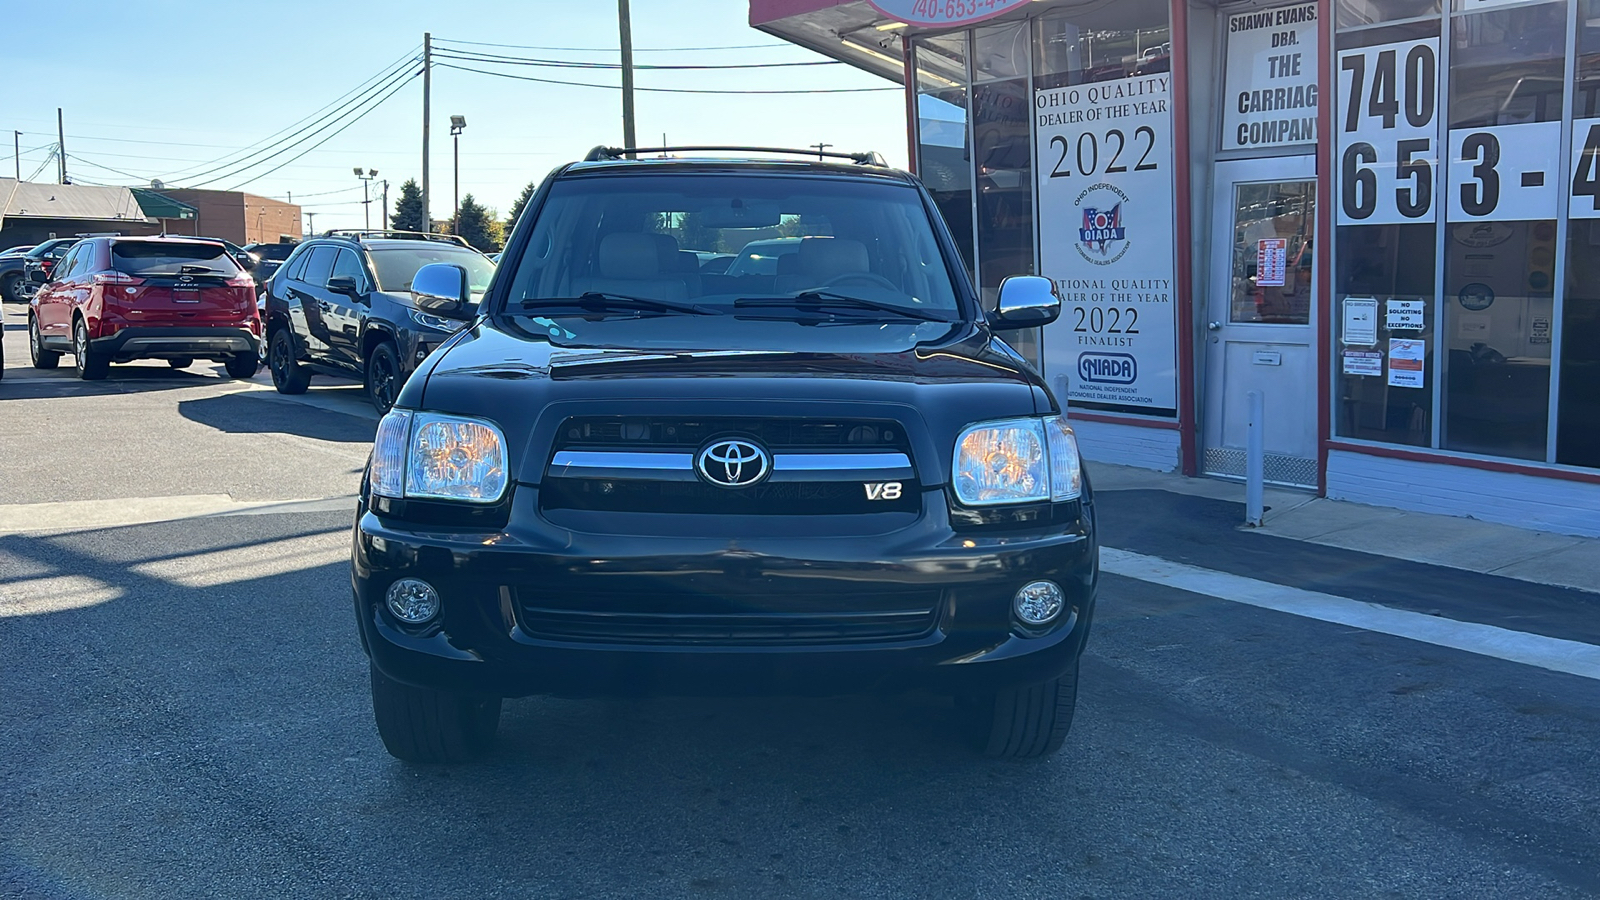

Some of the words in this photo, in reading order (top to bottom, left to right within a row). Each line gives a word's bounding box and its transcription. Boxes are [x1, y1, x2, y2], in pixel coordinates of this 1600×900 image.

[1230, 12, 1273, 33] SHAWN
[1276, 5, 1318, 26] EVANS.
[1271, 30, 1300, 48] DBA.
[1267, 53, 1302, 79] THE
[1036, 90, 1080, 109] OHIO
[1088, 77, 1169, 104] QUALITY
[1237, 84, 1318, 114] CARRIAG
[1341, 44, 1436, 133] 740
[1039, 110, 1084, 127] DEALER
[1086, 107, 1102, 122] OF
[1105, 104, 1130, 119] THE
[1132, 99, 1167, 116] YEAR
[1049, 125, 1158, 178] 2022
[1074, 189, 1088, 206] OHIO
[1087, 182, 1130, 204] INDEPENDENT
[1084, 228, 1118, 241] OIADA
[1055, 279, 1107, 290] TIONAL
[1111, 279, 1170, 291] QUALITY
[1060, 292, 1087, 302] ALER
[1091, 292, 1106, 302] OF
[1110, 293, 1132, 303] THE
[1137, 293, 1169, 303] YEAR
[1073, 306, 1140, 334] 2022
[1078, 335, 1134, 347] FINALIST
[1082, 358, 1132, 378] NIADA
[1079, 384, 1103, 392] NATIONAL
[1104, 386, 1138, 394] INDEPENDENT
[1096, 393, 1118, 401] DEALERS
[1118, 395, 1153, 403] ASSOCIATION
[863, 481, 903, 500] V8
